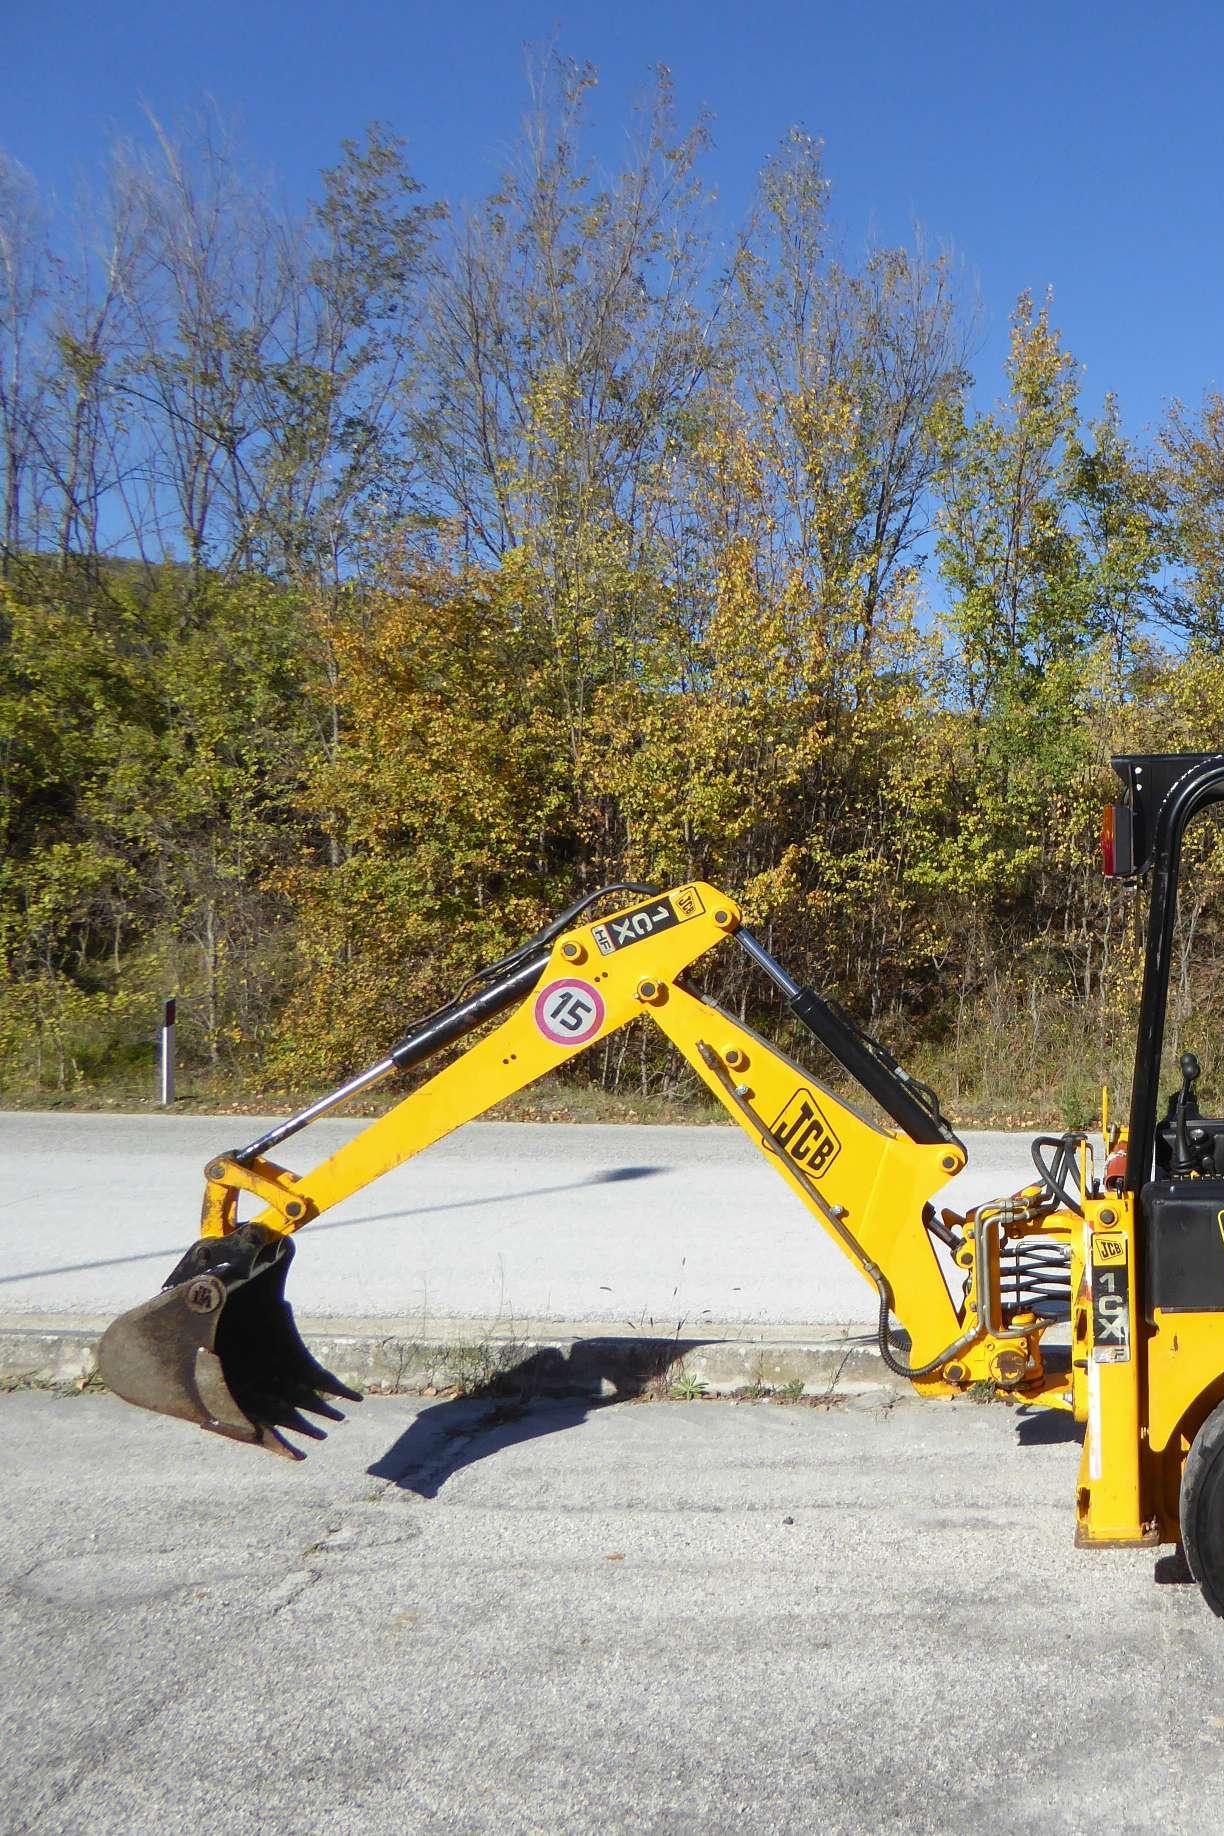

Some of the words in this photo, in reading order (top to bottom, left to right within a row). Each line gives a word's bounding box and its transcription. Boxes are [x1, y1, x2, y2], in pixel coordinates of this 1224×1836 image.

[594, 929, 612, 951] HF
[611, 905, 670, 945] 1CX
[550, 991, 593, 1032] 15
[773, 1100, 835, 1171] JCB
[1100, 1240, 1122, 1259] JCB
[1098, 1272, 1125, 1339] 1CX
